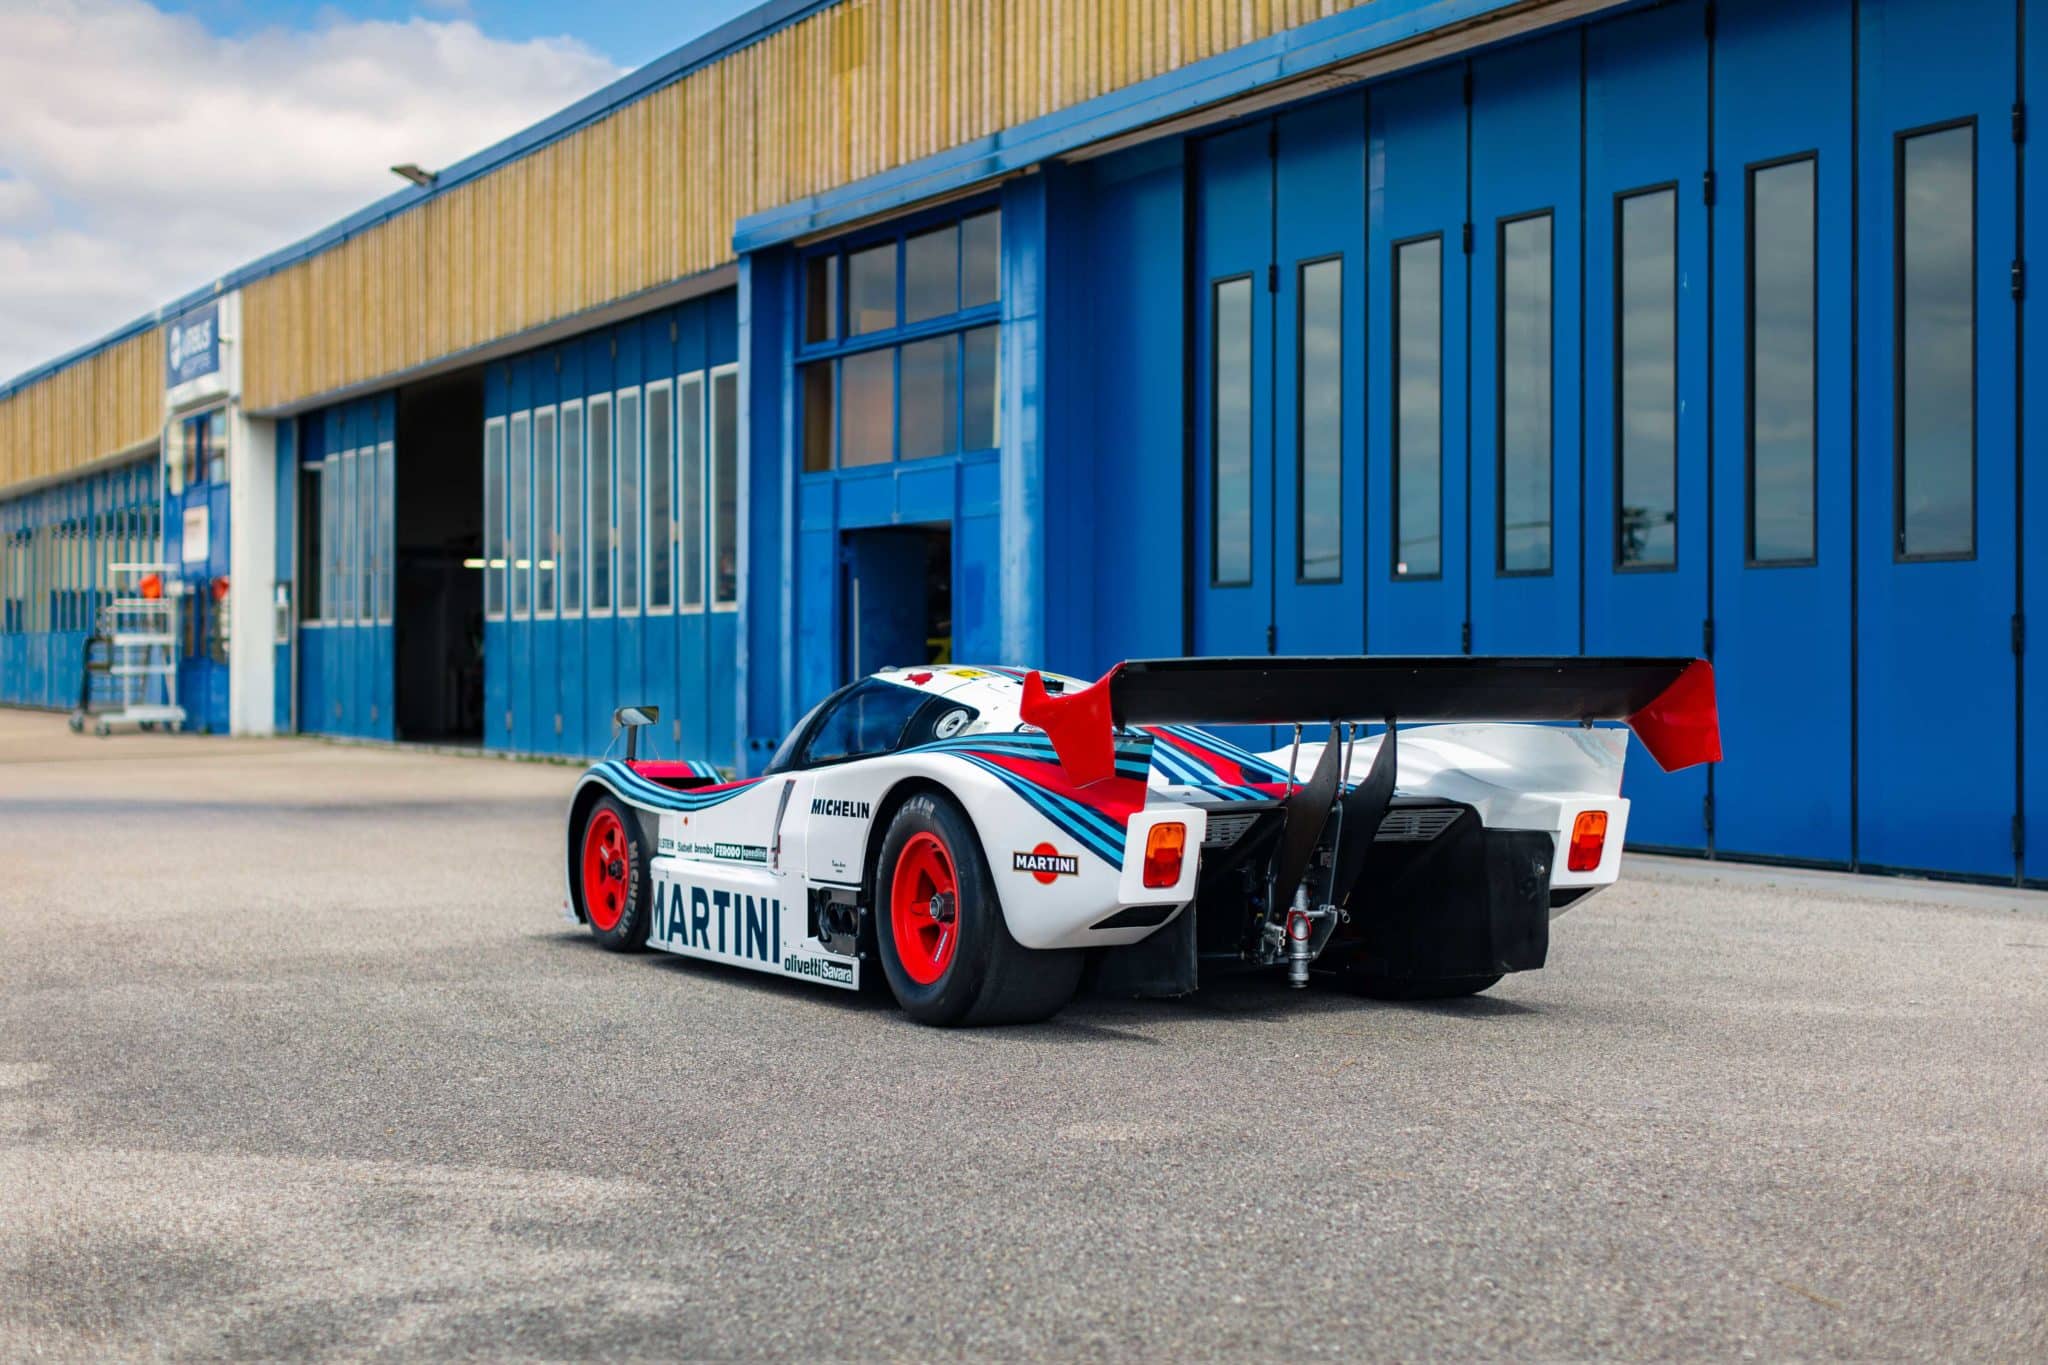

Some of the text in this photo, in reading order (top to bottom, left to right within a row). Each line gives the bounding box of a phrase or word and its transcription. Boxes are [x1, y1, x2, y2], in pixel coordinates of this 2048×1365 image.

[811, 798, 870, 819] MICHELIN
[694, 842, 713, 856] brembo
[715, 844, 741, 858] FERODO
[1015, 854, 1076, 873] MARTINI
[651, 880, 781, 964] MARTINI
[784, 954, 853, 982] olivetti Savara
